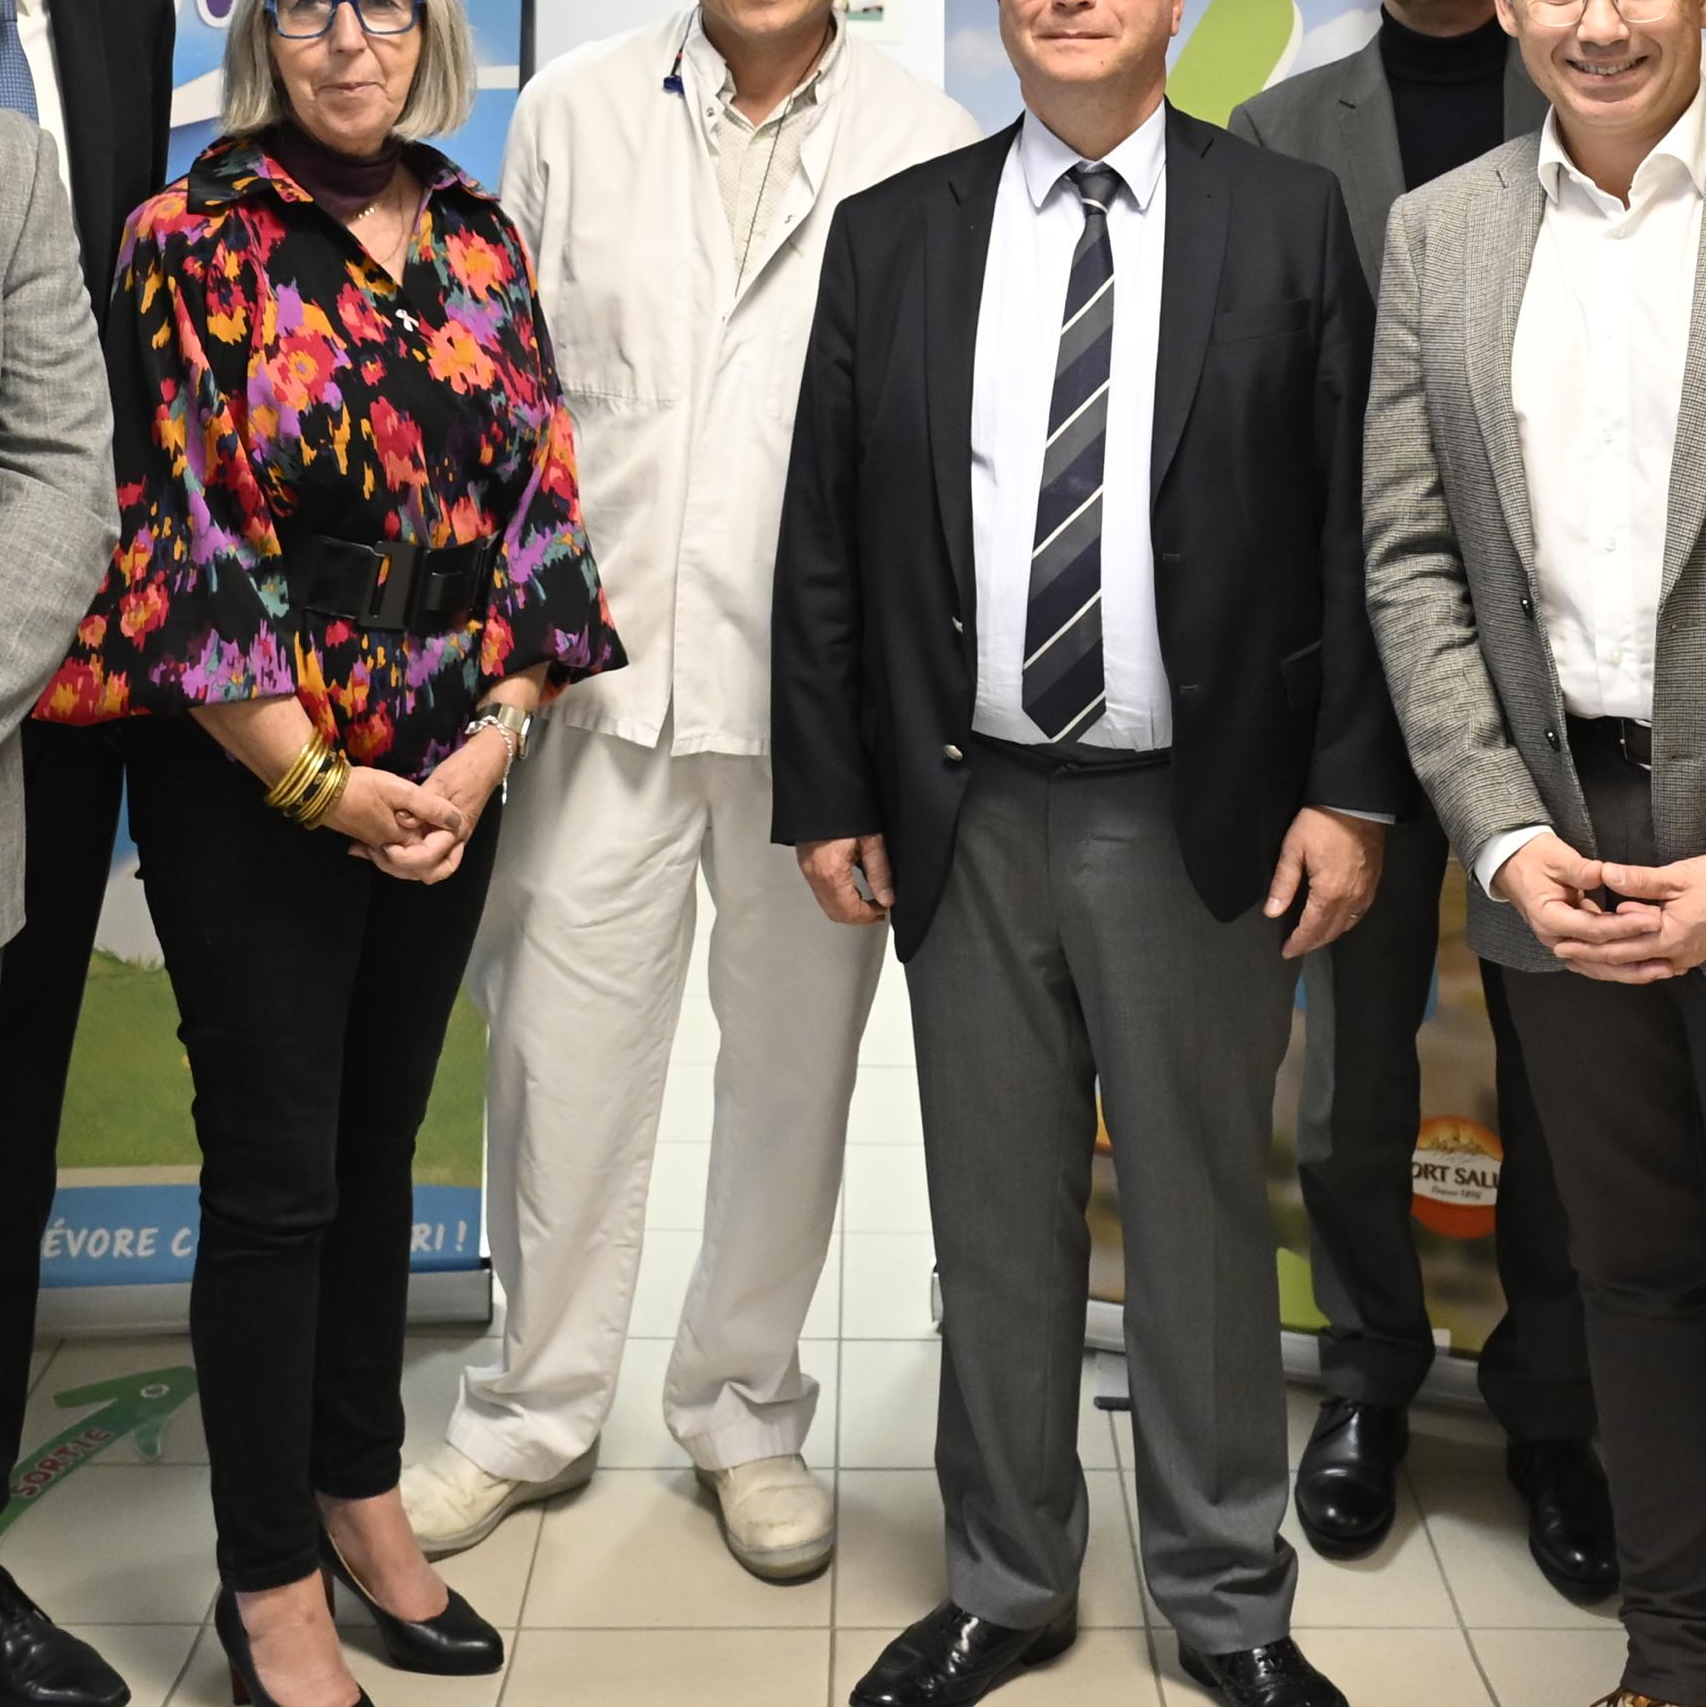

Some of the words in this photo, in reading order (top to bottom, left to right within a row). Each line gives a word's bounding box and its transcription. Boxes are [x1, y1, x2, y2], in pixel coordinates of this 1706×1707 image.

[1454, 1167, 1499, 1189] SAL
[43, 1218, 158, 1259] ÉVORE
[13, 1426, 113, 1498] SORTIE
